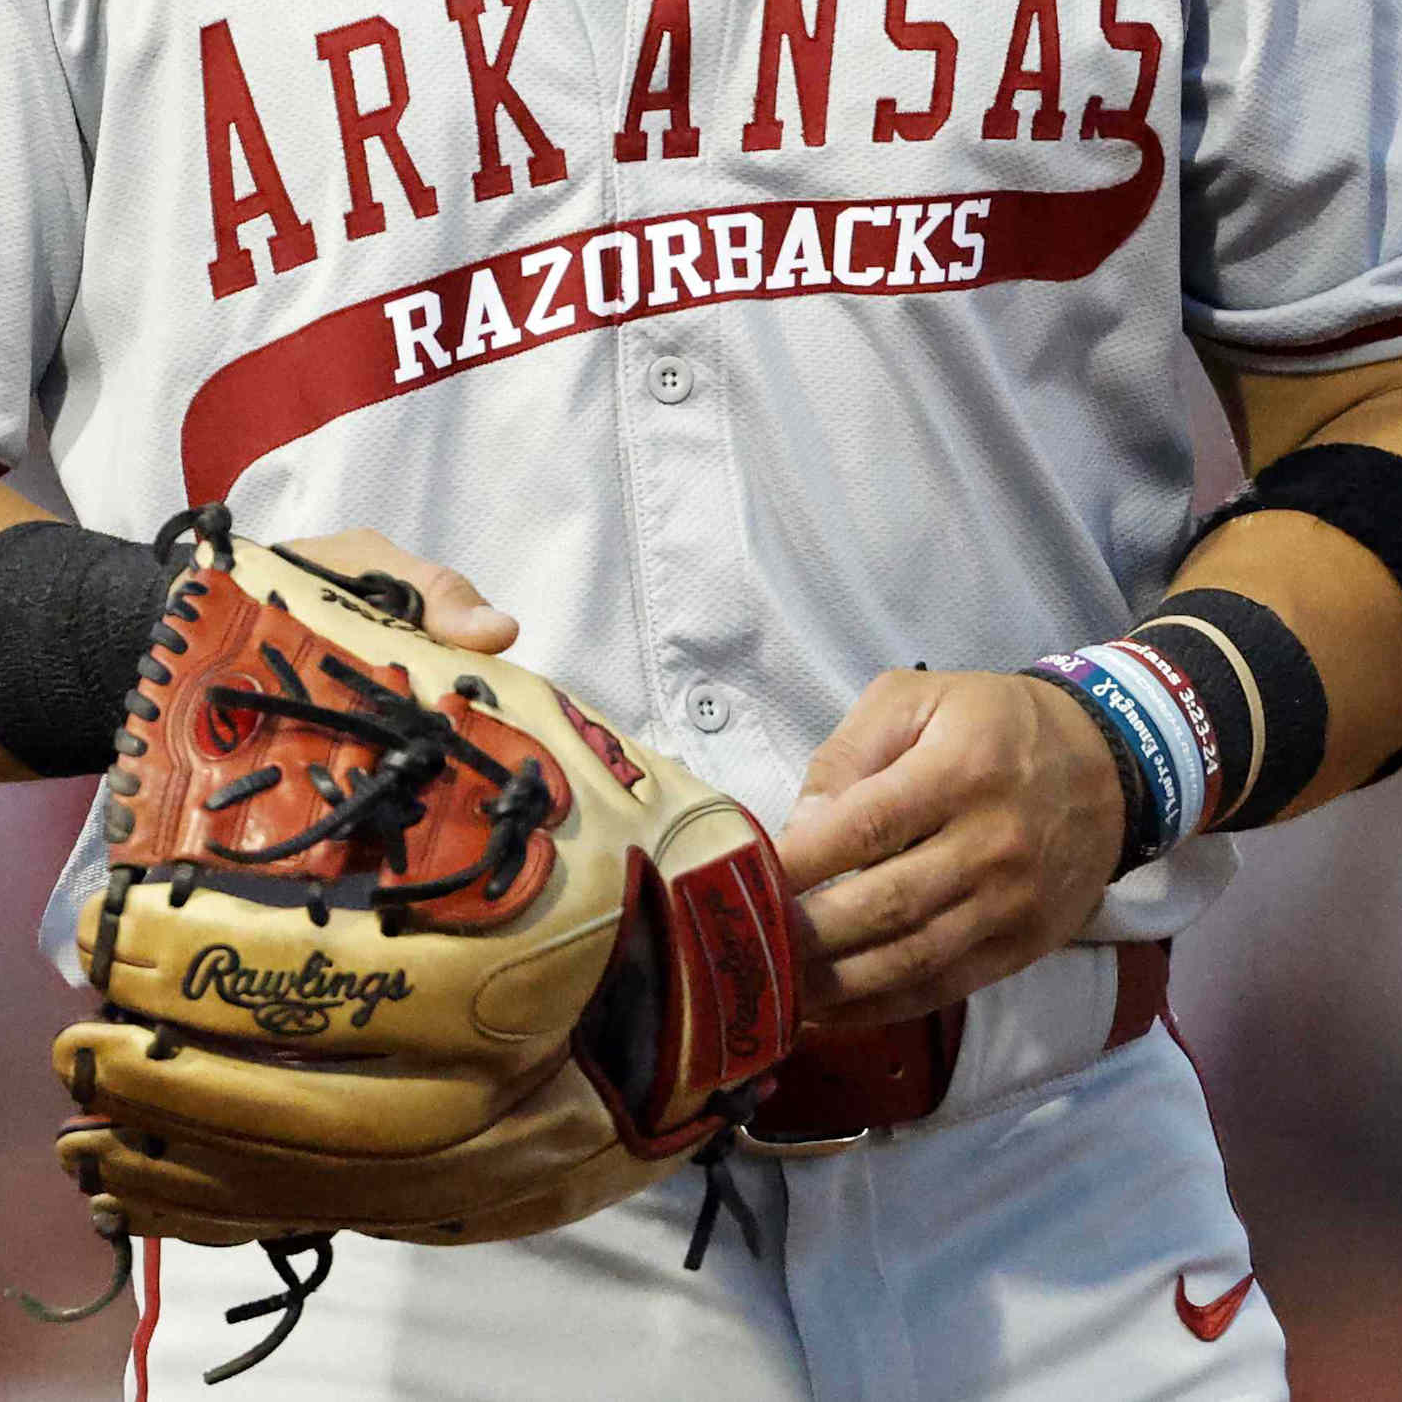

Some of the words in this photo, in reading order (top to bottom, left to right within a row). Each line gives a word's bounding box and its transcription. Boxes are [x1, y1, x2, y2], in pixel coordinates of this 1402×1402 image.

[384, 198, 991, 384] RAZORBACKS
[1109, 688, 1159, 759] Enough
[1178, 686, 1219, 775] 3:23-24
[182, 944, 415, 1028] Rawlings
